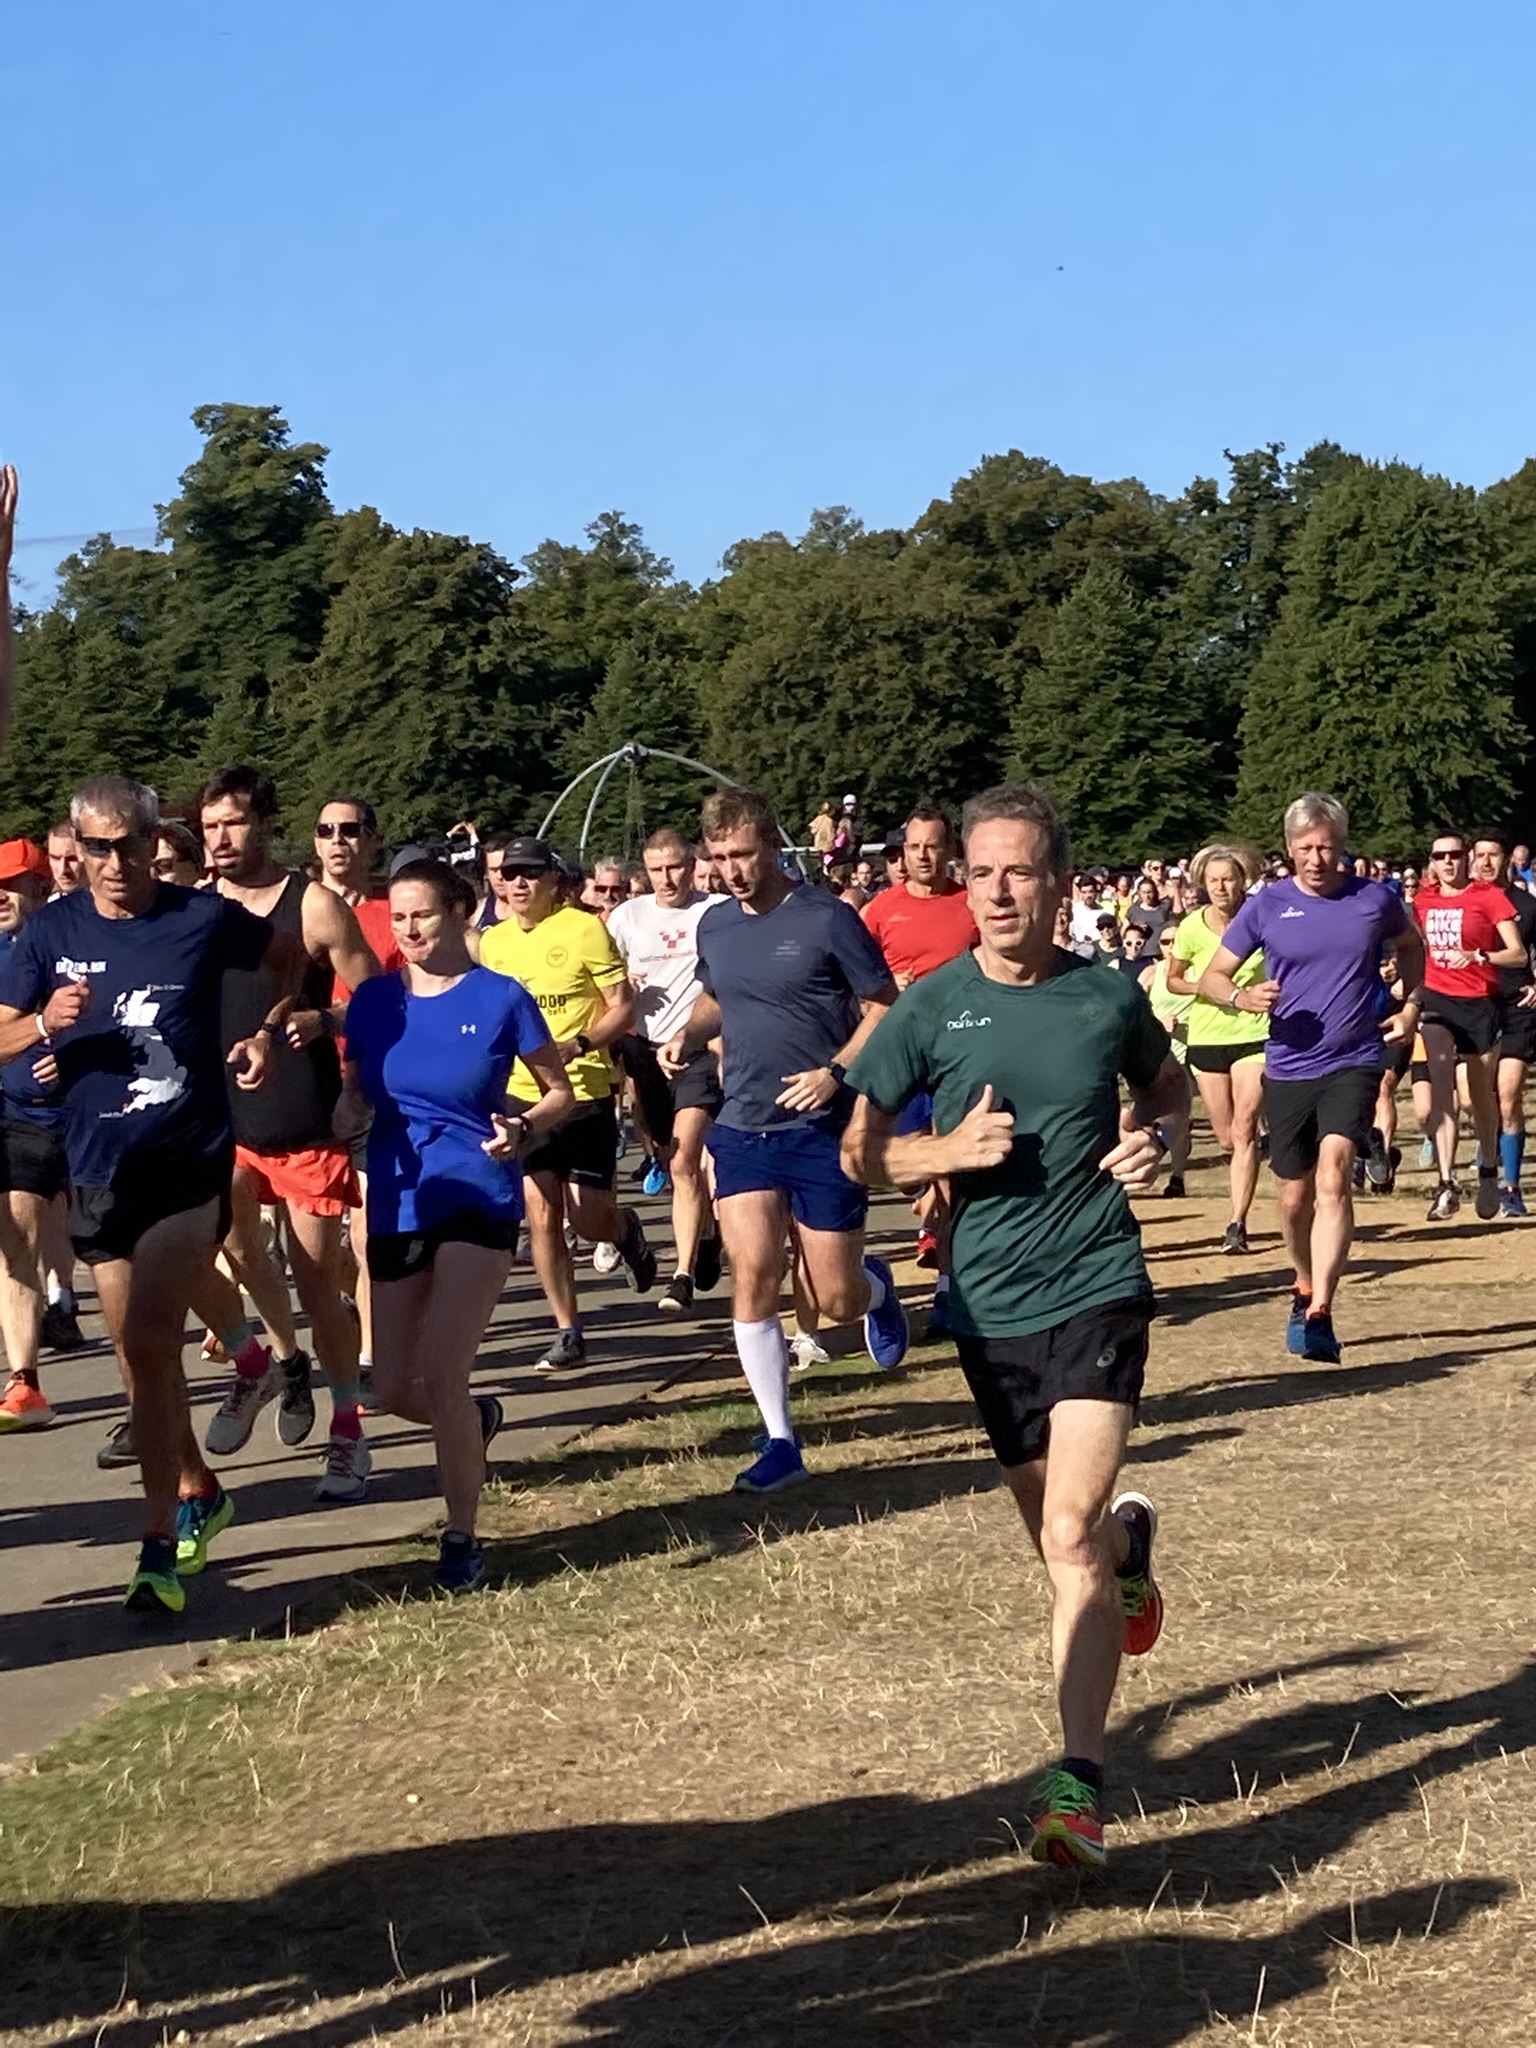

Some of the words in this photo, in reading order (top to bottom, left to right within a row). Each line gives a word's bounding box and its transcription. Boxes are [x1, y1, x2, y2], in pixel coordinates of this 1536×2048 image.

[1427, 908, 1464, 919] SWIM
[1426, 919, 1462, 932] BIKE
[1426, 932, 1462, 946] RUN
[535, 995, 567, 1008] OOD
